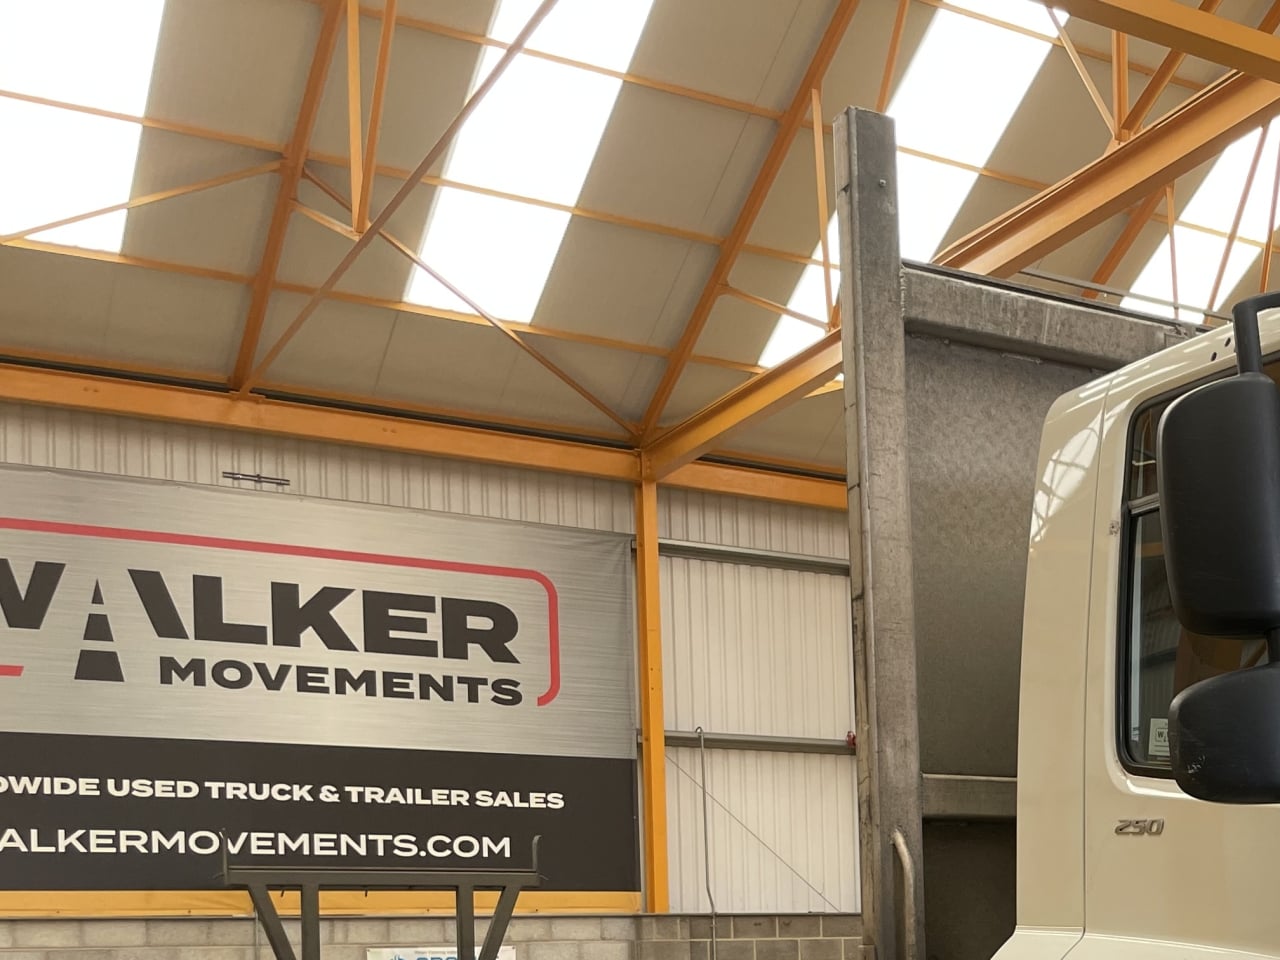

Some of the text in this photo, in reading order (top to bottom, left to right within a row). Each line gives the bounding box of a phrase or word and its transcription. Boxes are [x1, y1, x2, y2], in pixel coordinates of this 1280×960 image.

[159, 655, 523, 707] MOVEMENTS
[107, 778, 199, 799] USED
[204, 781, 314, 802] TRUCK
[319, 784, 341, 803] &
[344, 786, 470, 806] TRAILER
[475, 790, 565, 809] SALES
[1114, 819, 1165, 836] 250
[0, 828, 511, 858] ALKERMOVEMENTS.COM
